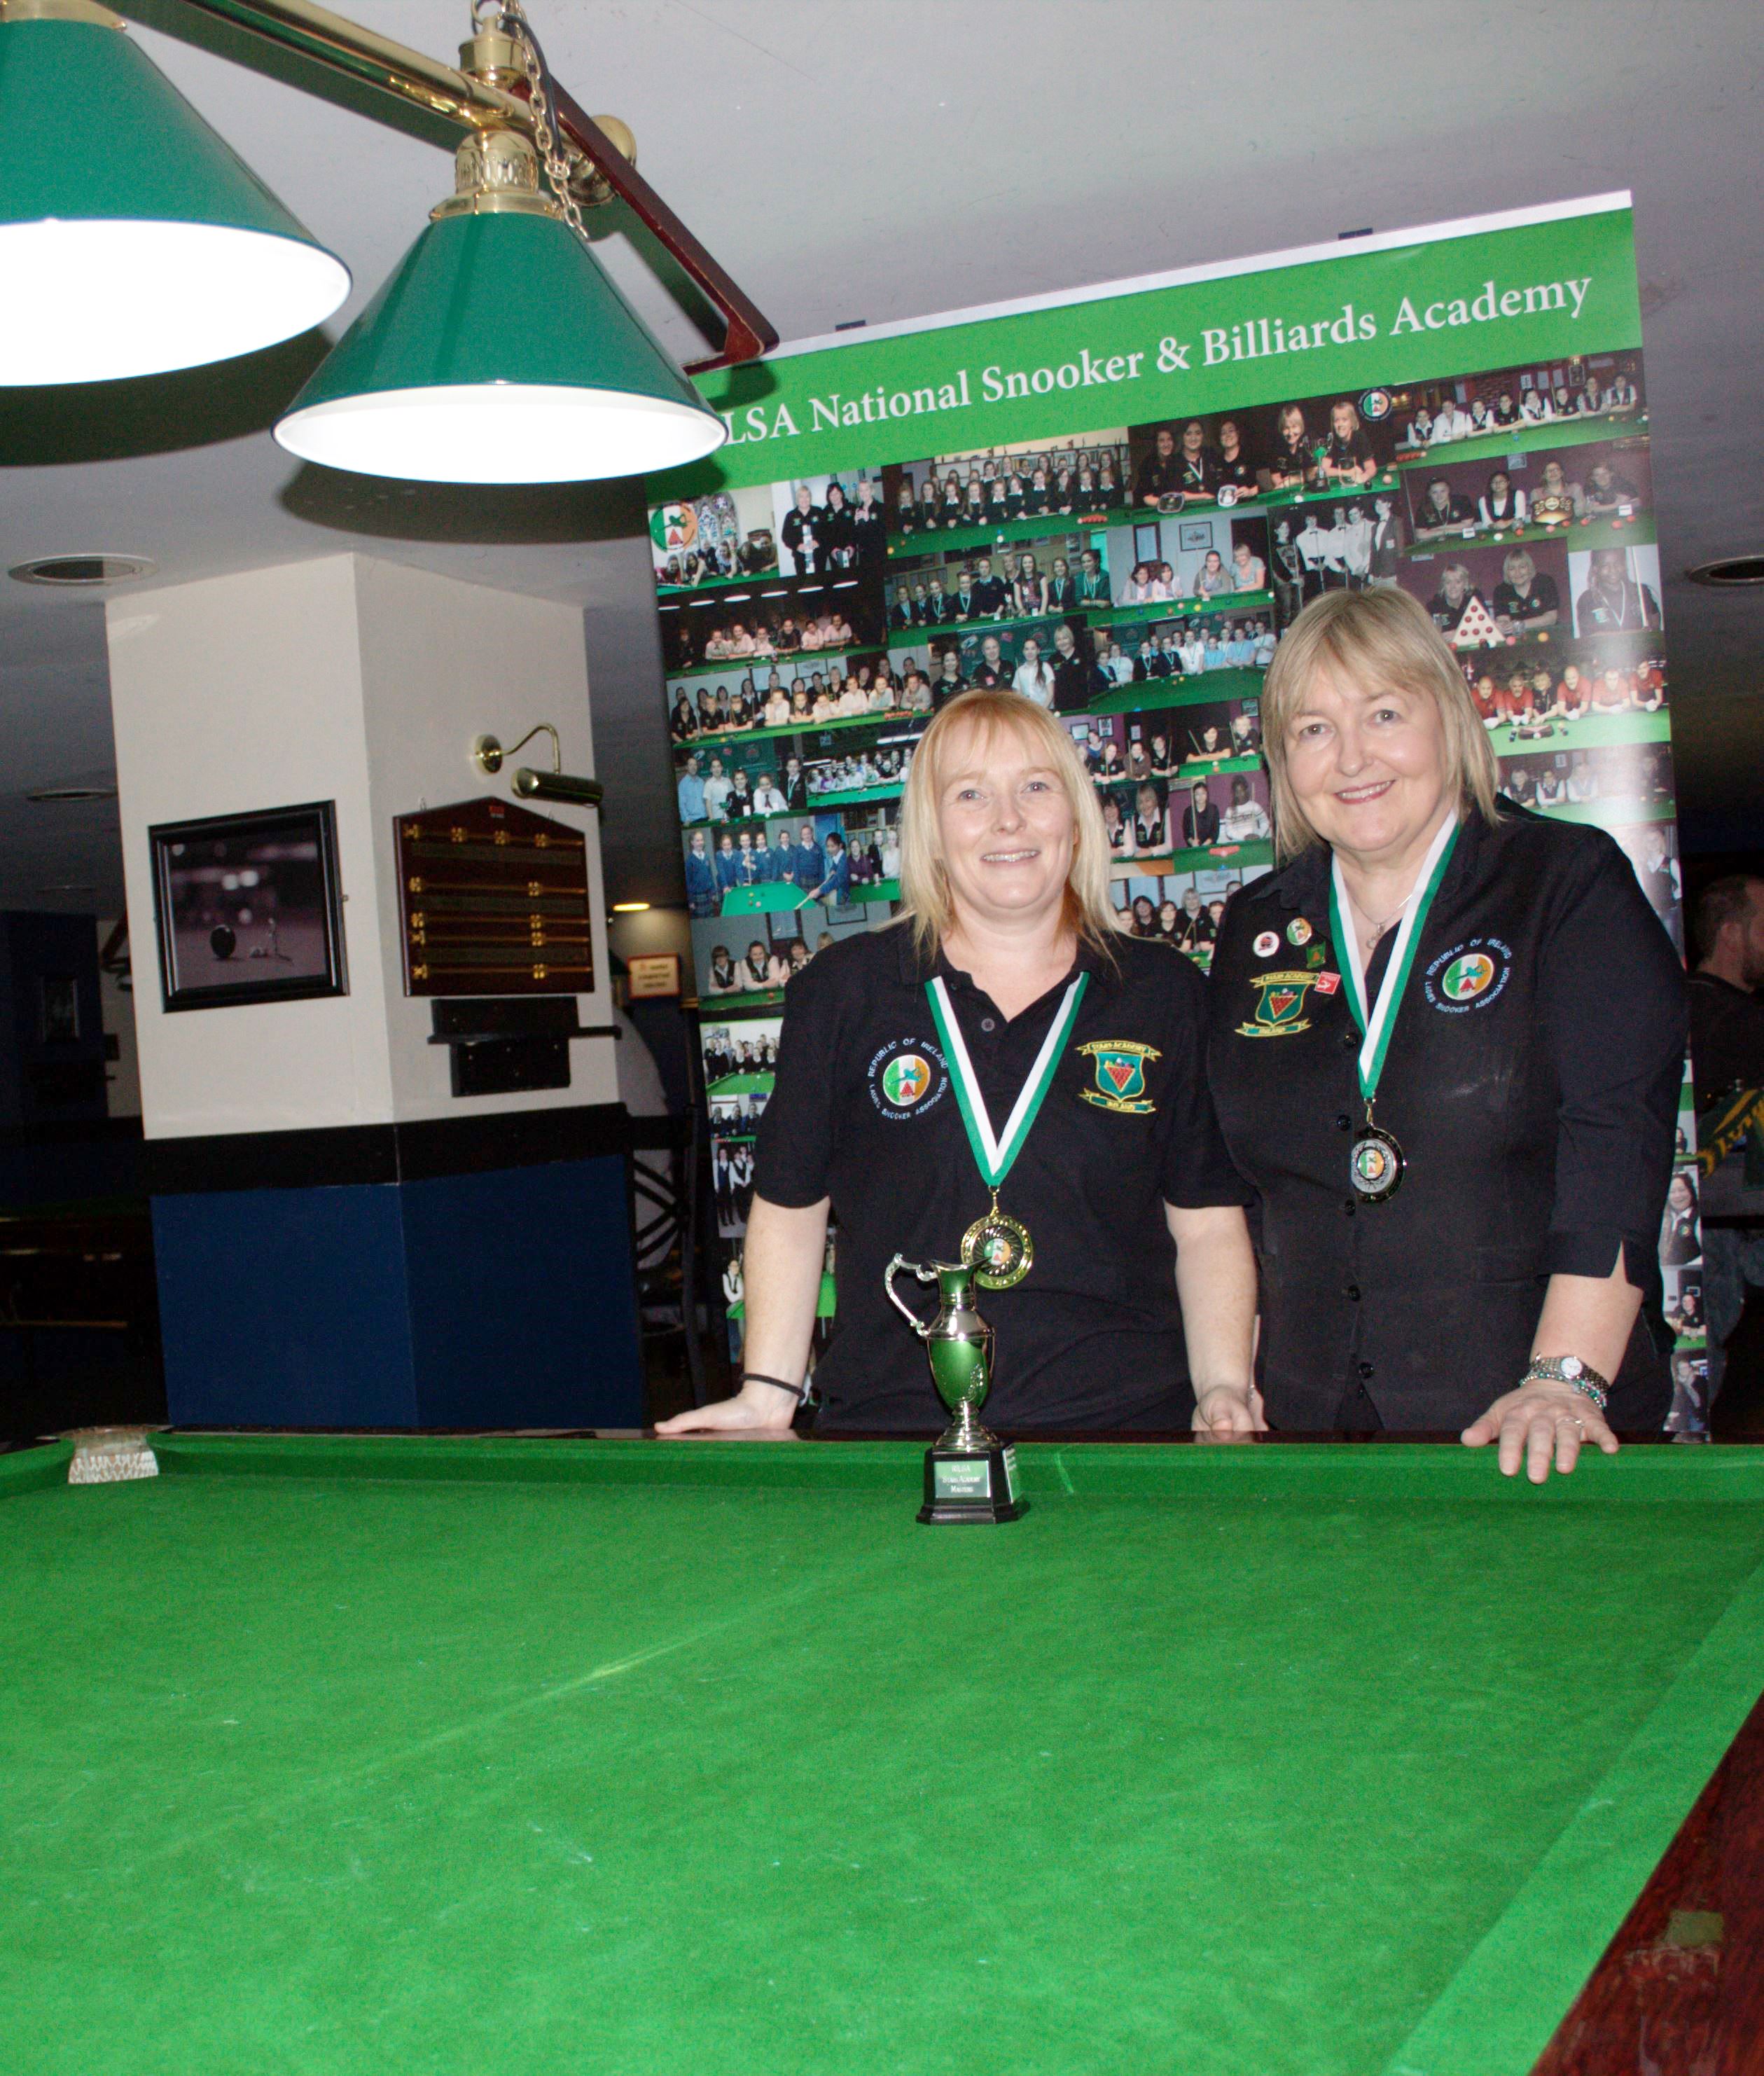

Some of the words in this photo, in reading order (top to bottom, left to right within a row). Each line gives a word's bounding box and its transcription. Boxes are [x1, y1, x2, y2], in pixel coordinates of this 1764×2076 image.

[721, 403, 800, 445] LSA
[809, 369, 972, 431] National
[982, 348, 1144, 401] Snooker
[1156, 336, 1190, 373] &
[1200, 303, 1377, 366] Billiards
[1389, 277, 1592, 335] Academy
[868, 1042, 896, 1077] REPUBLIC
